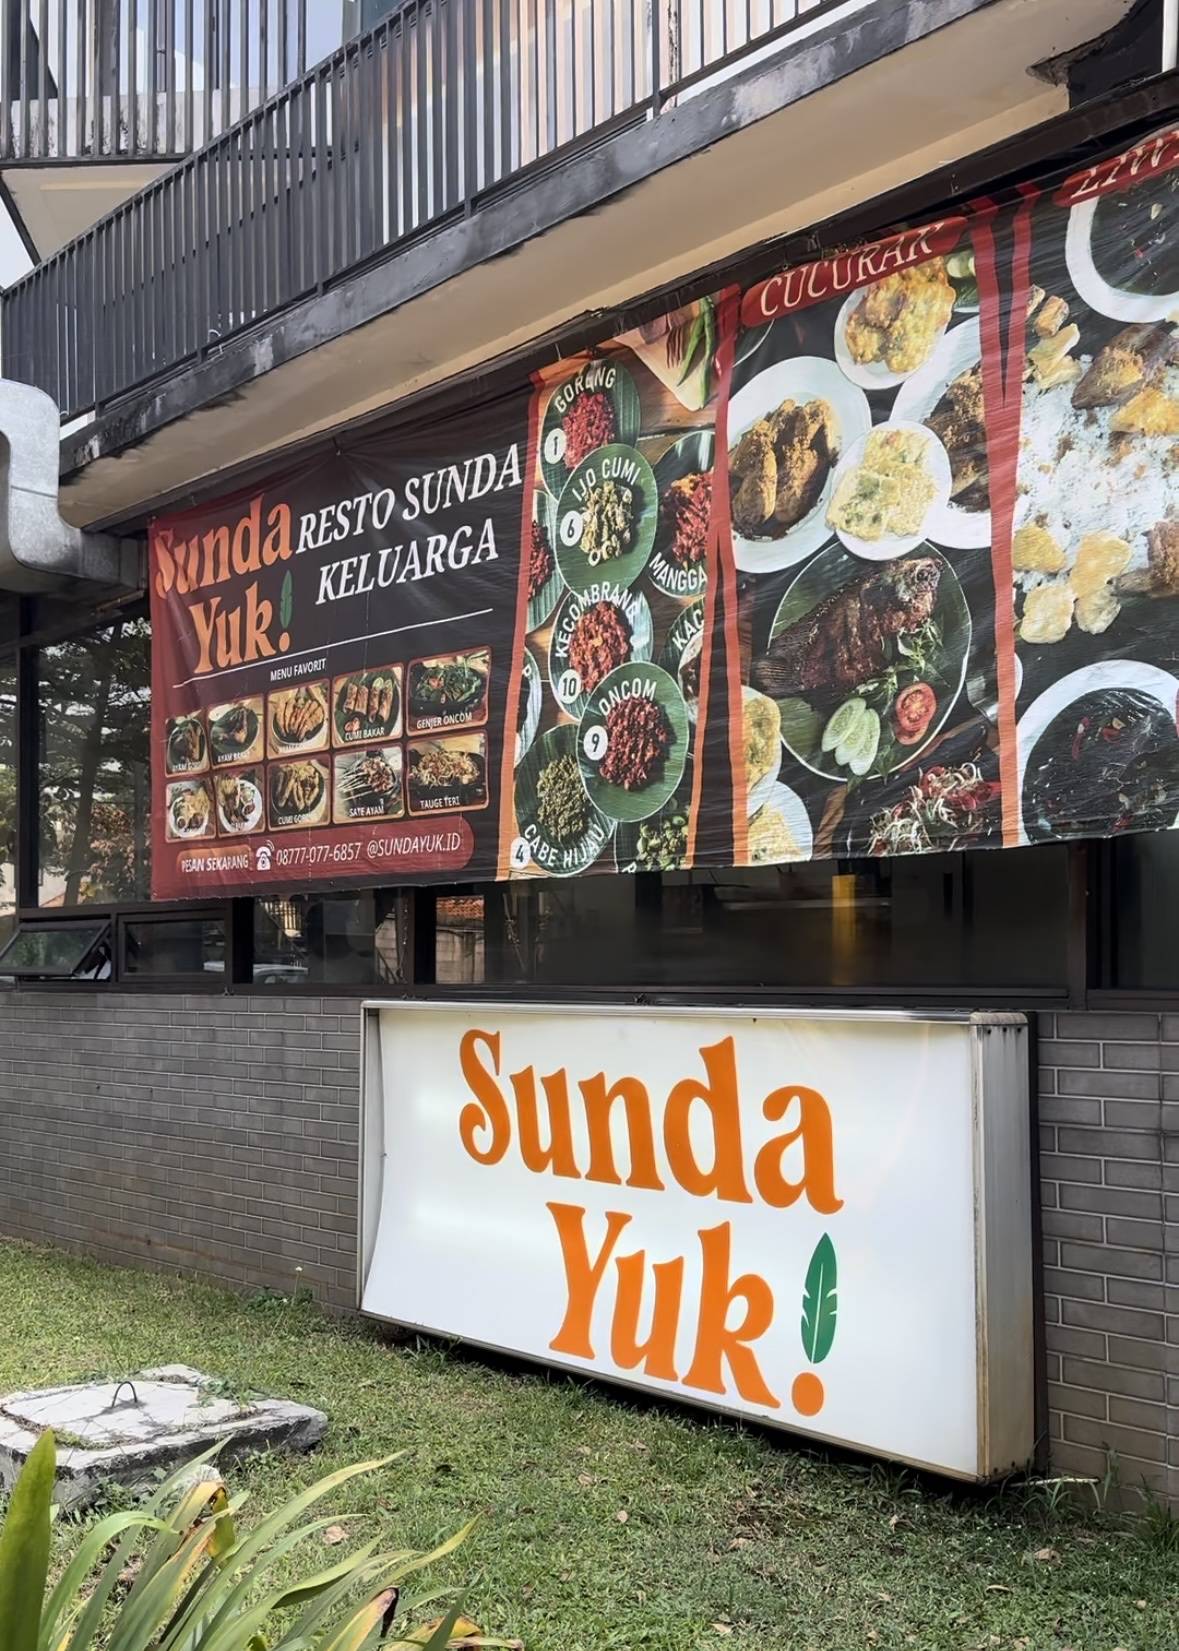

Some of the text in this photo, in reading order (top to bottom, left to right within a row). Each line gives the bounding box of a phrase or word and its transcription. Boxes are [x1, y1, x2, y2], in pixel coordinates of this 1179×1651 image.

[760, 222, 944, 316] CUCURAK
[572, 457, 641, 502] IJO CUMI
[296, 443, 523, 554] RESTO SUNDA
[567, 519, 575, 538] 6
[154, 493, 293, 599] Sunda
[315, 518, 499, 605] KELUARGA
[649, 551, 708, 591] MANGGA
[270, 658, 326, 681] MENU FAVORIT
[562, 678, 577, 697] 10
[598, 678, 657, 716] ONCOM
[363, 727, 385, 739] BAKAR
[416, 711, 473, 730] GENJER ONCOM
[591, 733, 600, 753] 9
[366, 805, 384, 815] AYAM
[420, 796, 460, 809] TAUGE TERI
[276, 832, 461, 866] 08777-077-6857 @SUNDAYUK.ID
[515, 844, 524, 862] 4
[524, 824, 604, 868] CABE HIJAU
[181, 855, 249, 873] PESAN SEKARANG
[458, 1028, 845, 1215] Sunda
